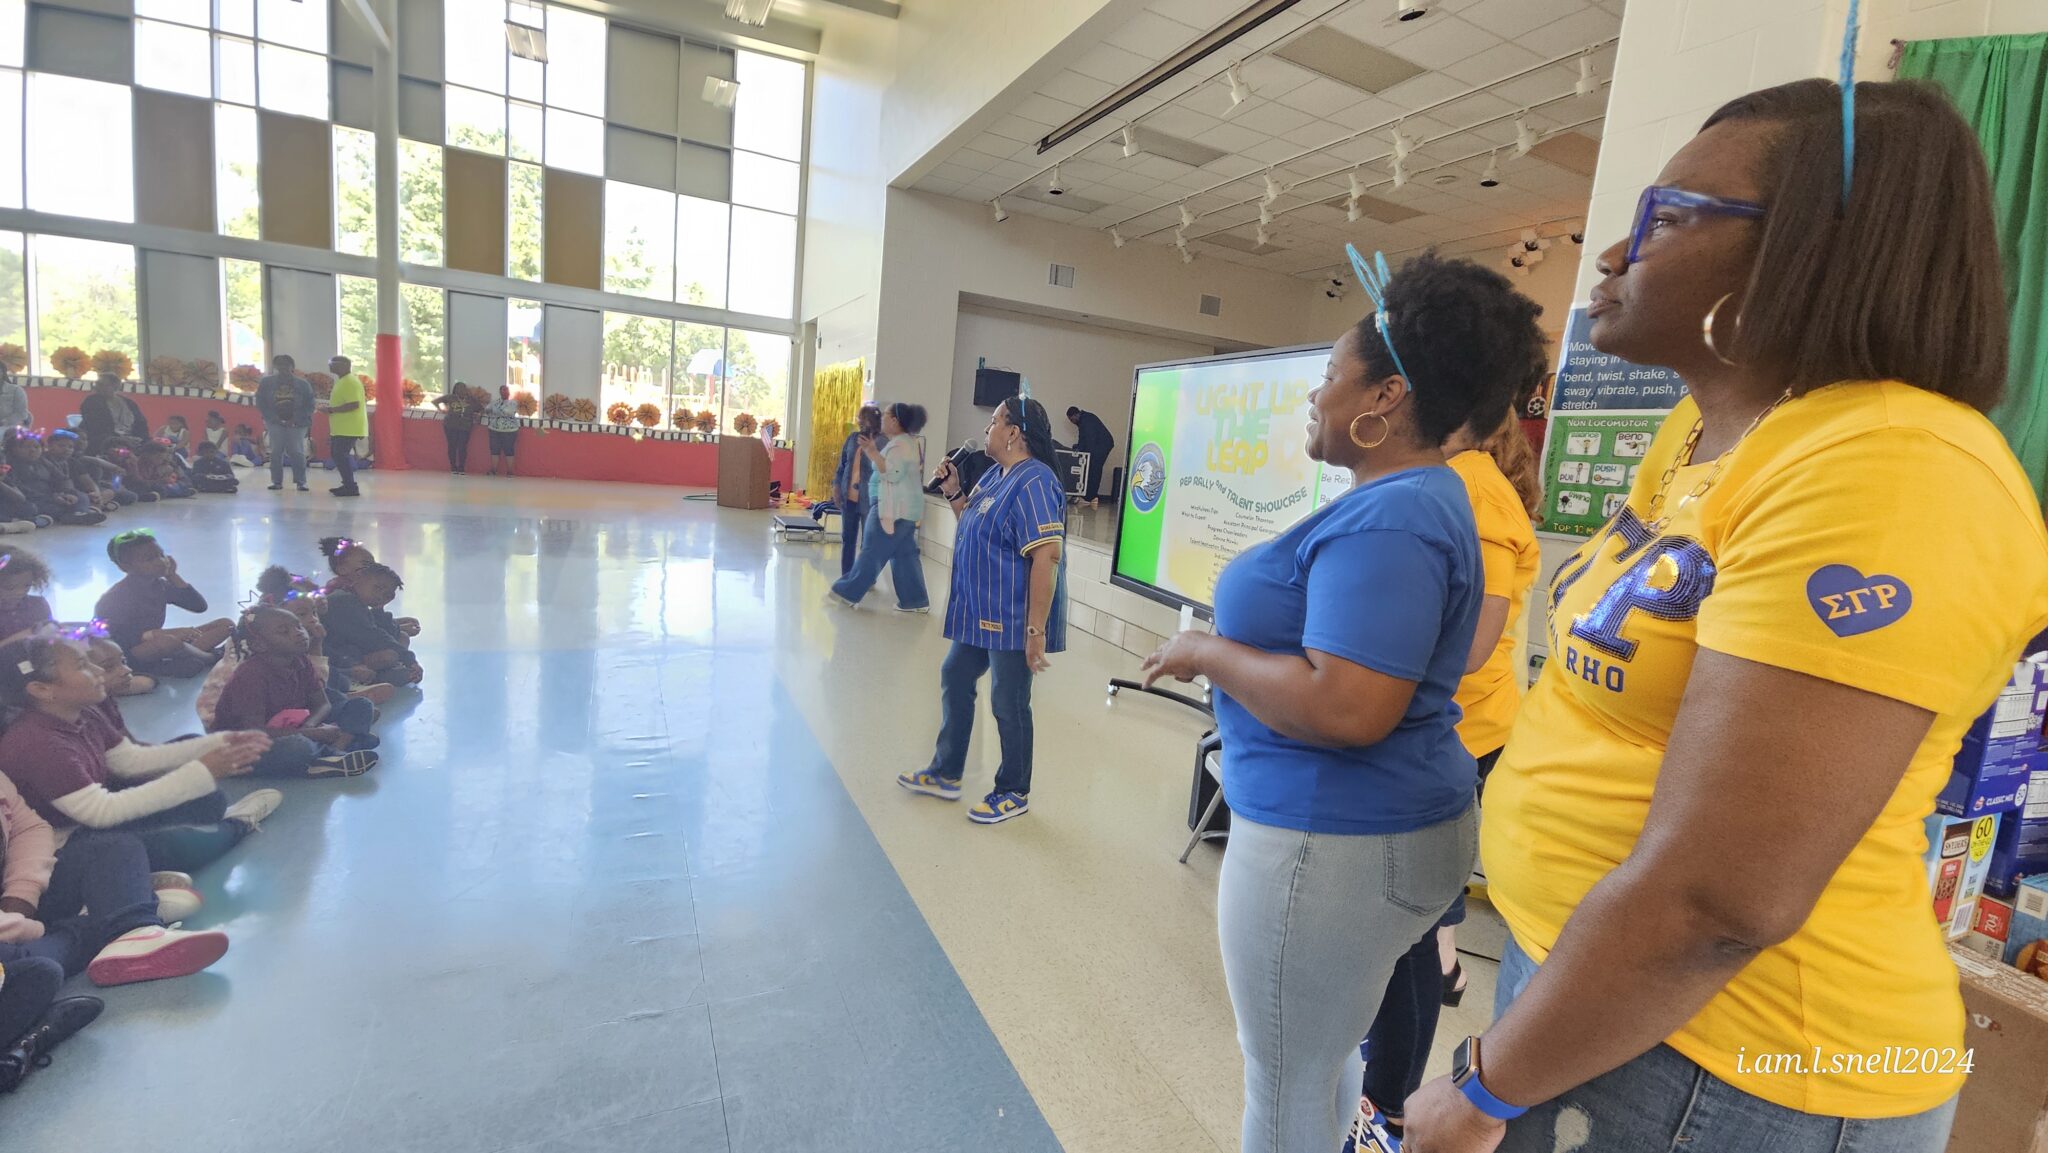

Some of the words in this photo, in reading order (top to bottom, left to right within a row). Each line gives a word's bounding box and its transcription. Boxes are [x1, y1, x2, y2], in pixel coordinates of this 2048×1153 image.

[1569, 356, 1608, 367] staying
[1610, 356, 1621, 364] in
[1597, 371, 1626, 381] twist,
[1628, 369, 1669, 380] shake,
[1196, 381, 1265, 416] LIGHT
[1268, 379, 1309, 415] UP
[1564, 387, 1594, 398] sway,
[1597, 385, 1639, 396] vibrate,
[1642, 384, 1676, 397] push,
[1561, 400, 1598, 410] stretch
[1213, 407, 1272, 449] THE
[1206, 440, 1269, 477] LEAP
[1321, 473, 1332, 483] Be
[1179, 476, 1193, 487] PEP
[1194, 475, 1215, 490] RALLY
[1215, 479, 1227, 494] and
[1226, 488, 1255, 512] TALENT
[1255, 486, 1308, 513] SHOWCASE
[1553, 523, 1572, 532] TOP
[1566, 646, 1625, 693] RHO
[1976, 817, 1993, 839] 60
